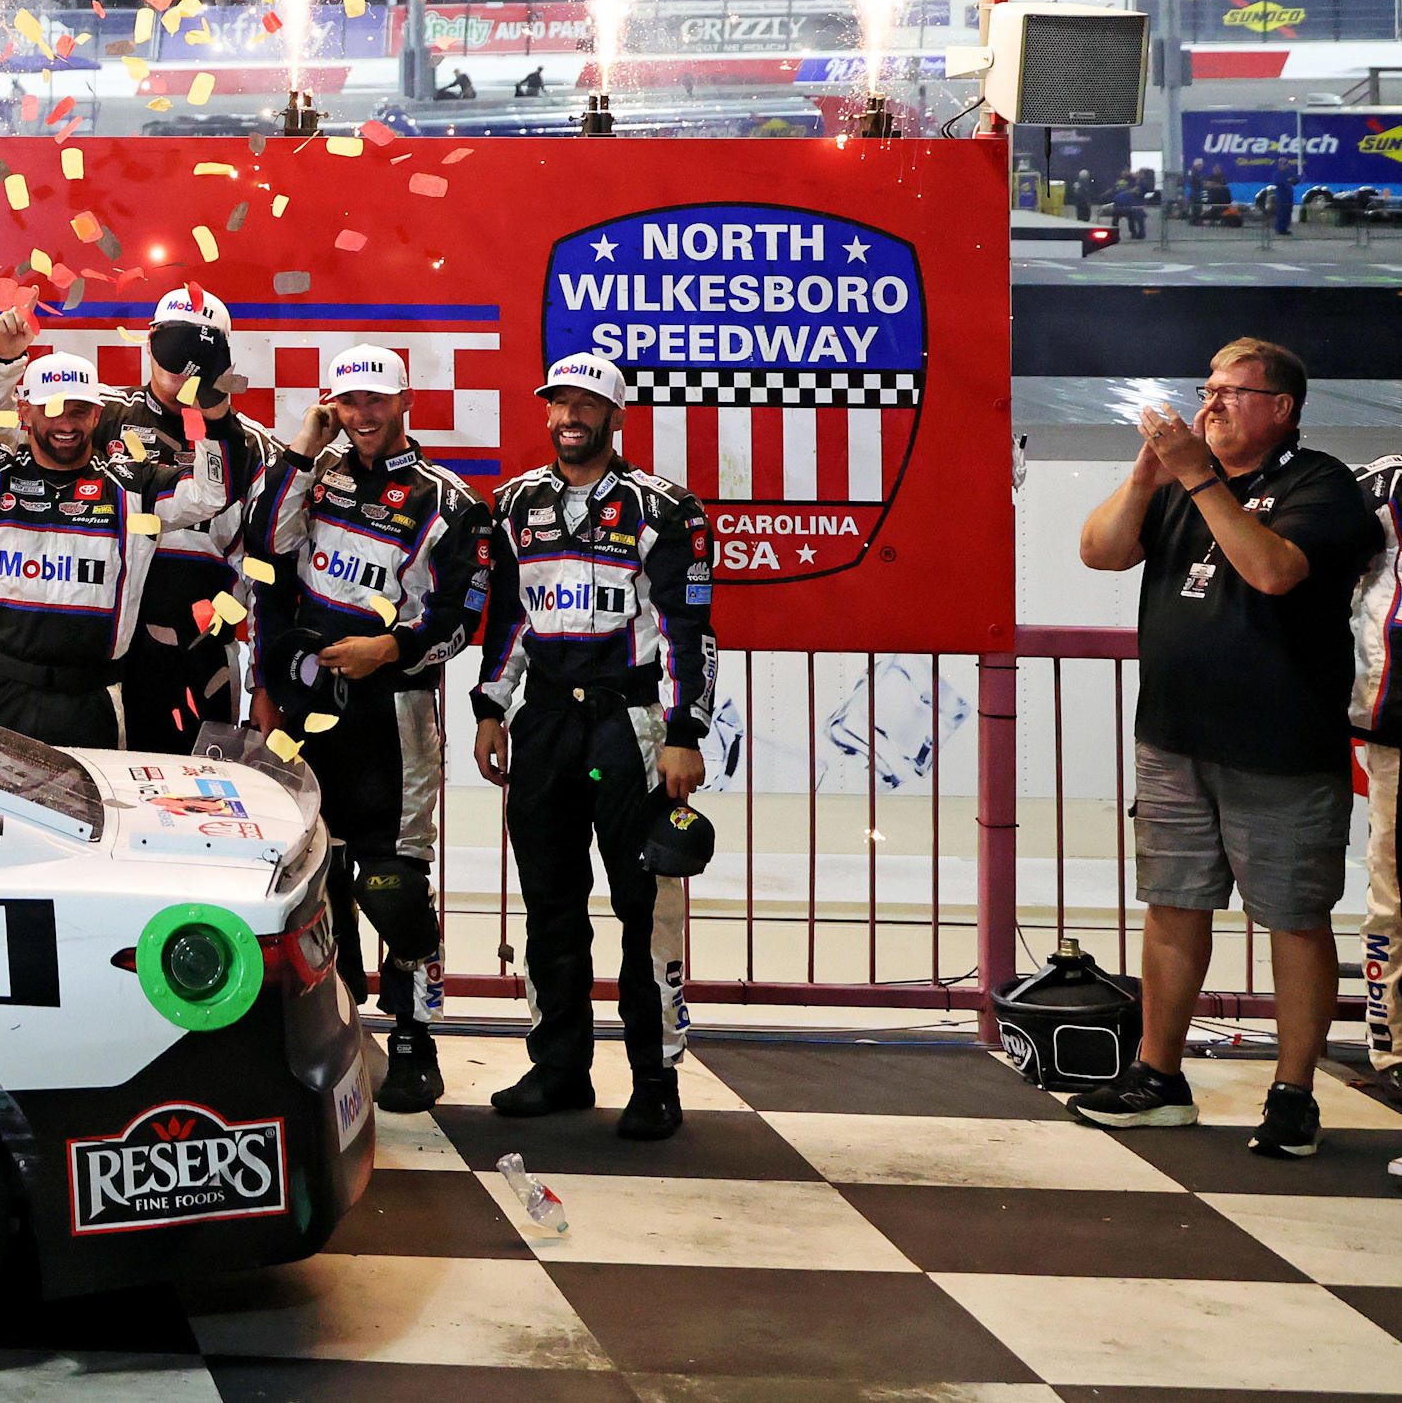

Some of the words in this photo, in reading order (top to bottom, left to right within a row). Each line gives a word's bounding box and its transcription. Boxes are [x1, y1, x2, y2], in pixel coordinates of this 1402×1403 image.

[1223, 8, 1305, 24] SUNOCO
[681, 16, 807, 41] GRIZZLY
[643, 223, 825, 261] NORTH
[559, 273, 909, 314] WILKESBORO
[167, 301, 194, 312] Mob
[591, 324, 879, 363] SPEEDWAY
[41, 371, 78, 384] Mobil
[336, 361, 369, 377] Mobil
[553, 363, 587, 378] Mobil
[389, 456, 407, 468] Mobil
[596, 480, 611, 497] Mobil
[717, 513, 859, 536] CAROLINA
[526, 584, 590, 612] Mobil
[1366, 933, 1390, 1028] Mobil
[88, 1131, 272, 1221] RESER'S
[135, 1194, 170, 1212] FINE
[175, 1189, 226, 1208] FOODS
